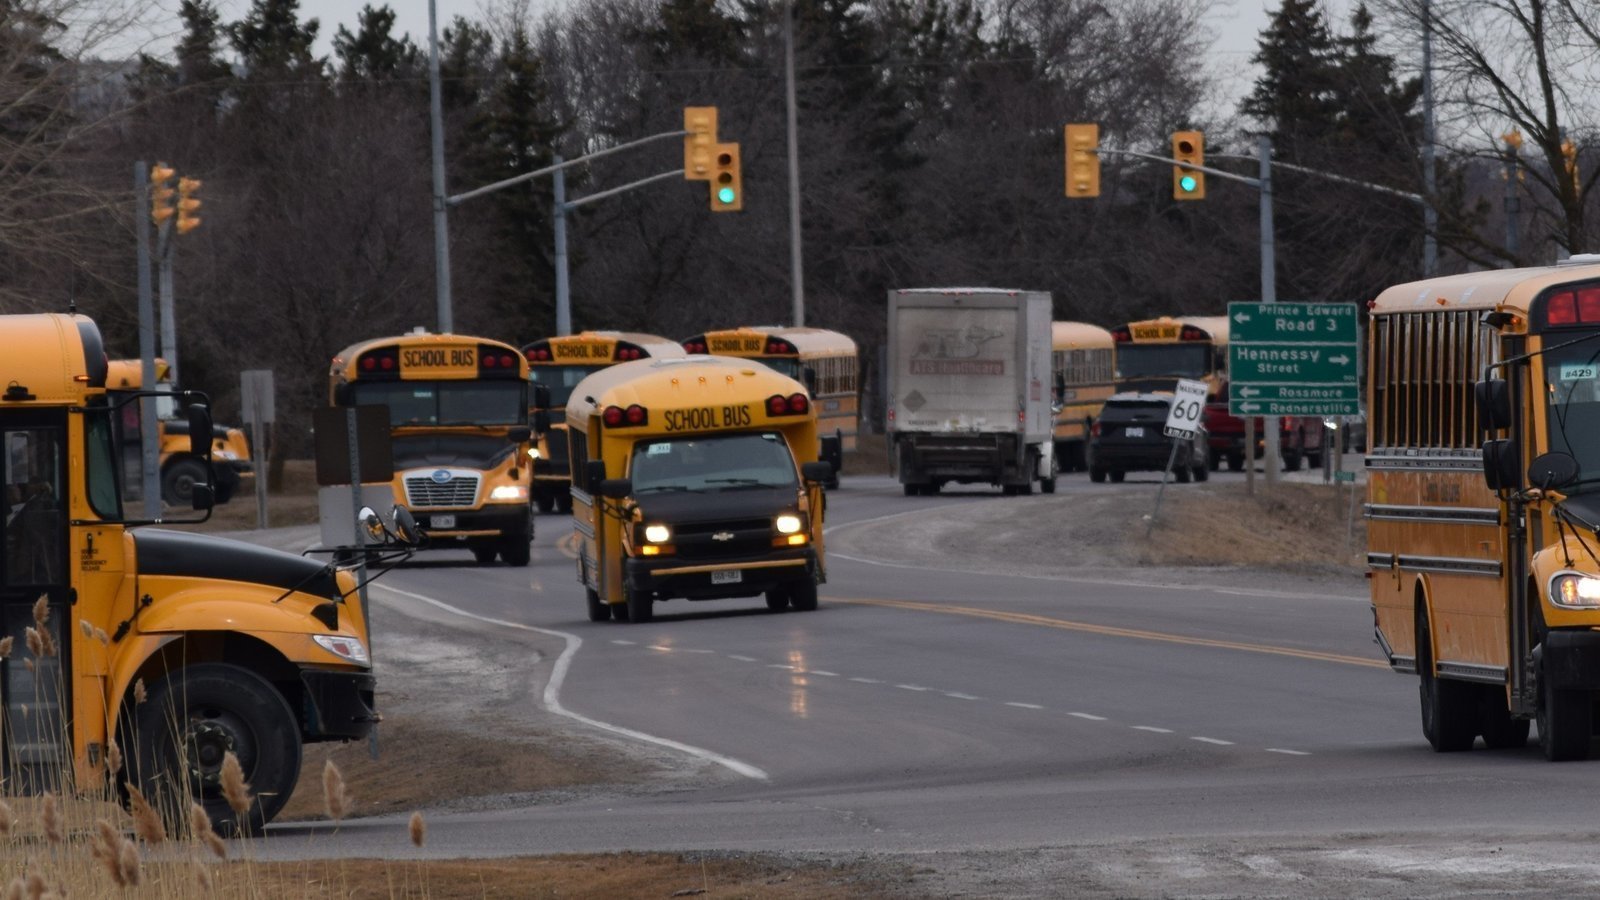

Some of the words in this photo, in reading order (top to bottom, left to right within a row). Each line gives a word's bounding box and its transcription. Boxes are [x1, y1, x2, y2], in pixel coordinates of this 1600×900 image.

[1258, 306, 1300, 315] Prince
[1306, 306, 1352, 316] Edward
[1275, 319, 1315, 331] Road
[1326, 319, 1337, 331] 3
[556, 345, 588, 357] SCHOOL
[591, 345, 609, 357] BUS
[712, 340, 741, 351] SCHOOL
[744, 339, 761, 351] BUS
[403, 351, 449, 367] SCHOOL
[451, 350, 474, 366] BUS
[1237, 347, 1320, 363] Hennessy
[1258, 363, 1300, 373] Street
[1565, 369, 1592, 378] #429
[1279, 388, 1342, 398] Rossmore
[1173, 400, 1200, 421] 60
[1270, 403, 1351, 413] Rednersville
[664, 408, 720, 432] SCHOOL
[723, 405, 751, 426] BUS
[1168, 428, 1190, 440] km/h
